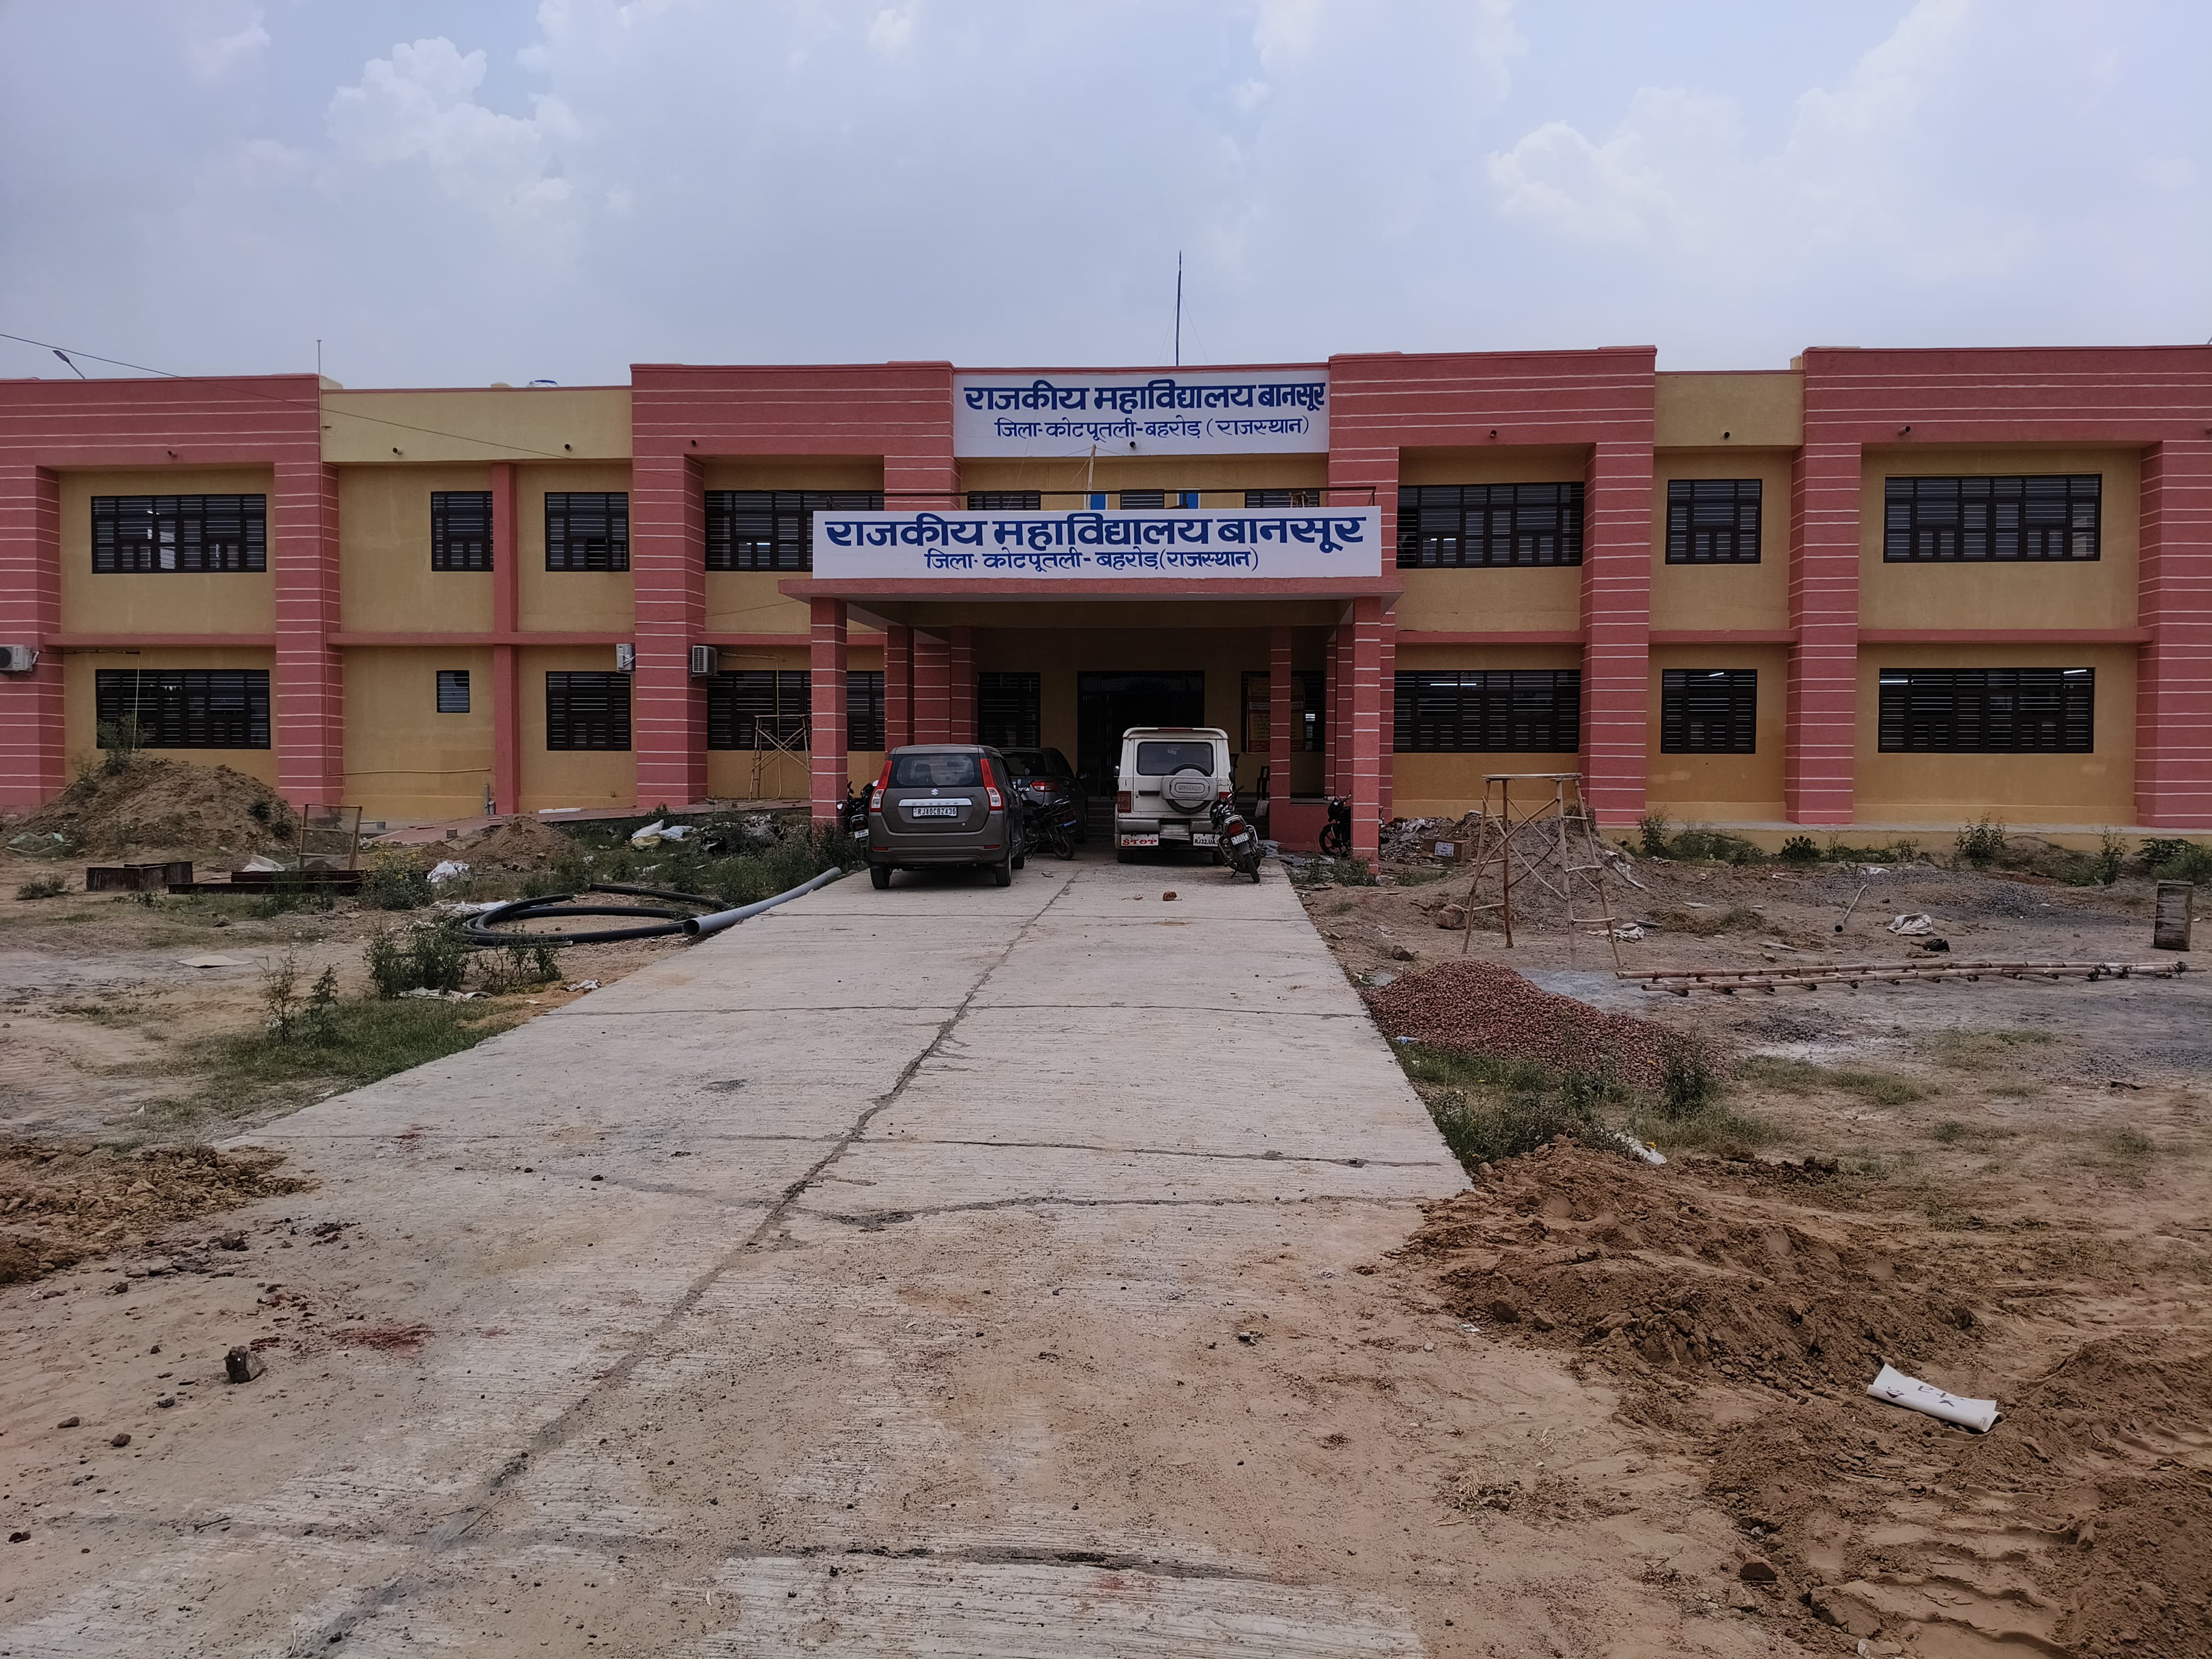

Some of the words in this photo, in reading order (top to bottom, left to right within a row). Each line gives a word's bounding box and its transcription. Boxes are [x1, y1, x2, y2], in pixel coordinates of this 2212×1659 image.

[963, 380, 1090, 410] राजकीय
[1094, 379, 1257, 414] महाविद्यालय
[1258, 382, 1325, 411] बानसूर
[1207, 415, 1309, 437] (राजस्थान)
[825, 513, 988, 546] राजकीय
[992, 513, 1213, 551] महाविद्यालय
[1217, 517, 1367, 553] बानसूर
